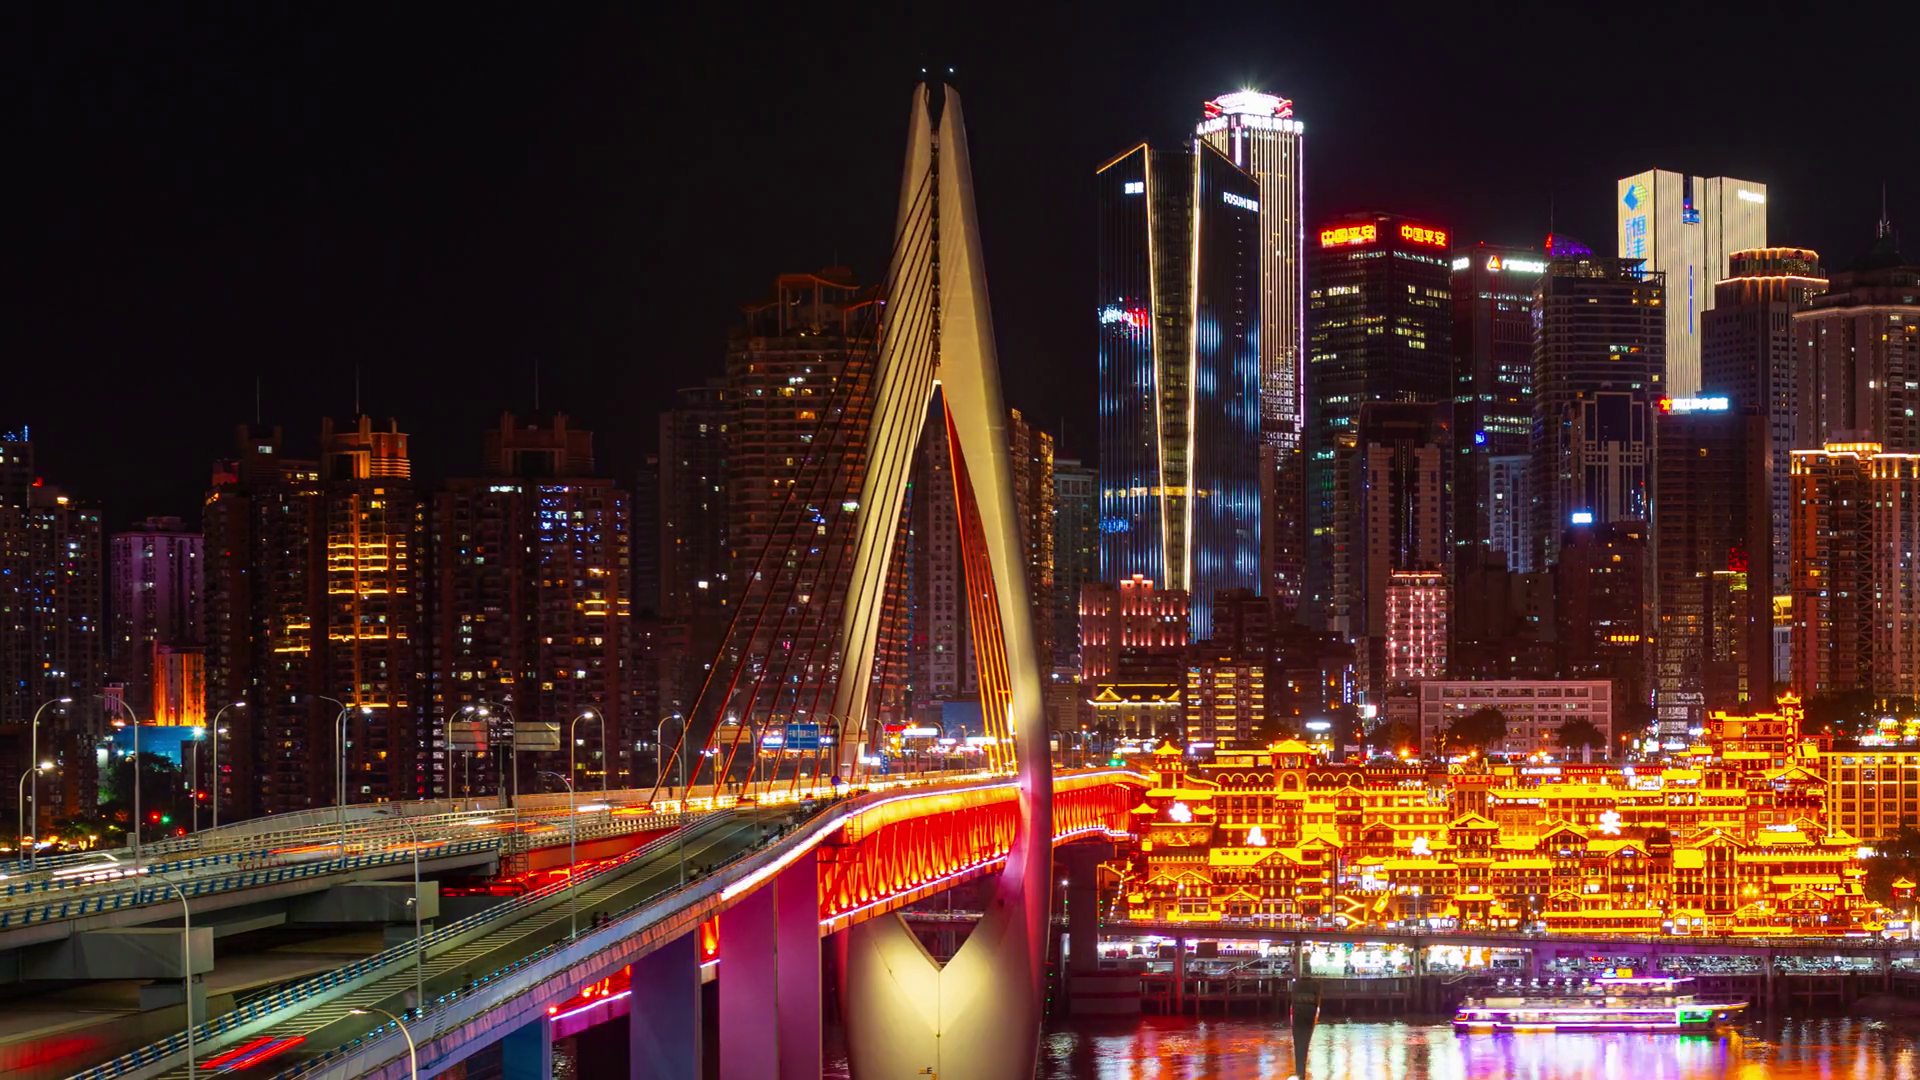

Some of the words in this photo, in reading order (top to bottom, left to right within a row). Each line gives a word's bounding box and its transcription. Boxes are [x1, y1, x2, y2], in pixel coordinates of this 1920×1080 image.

[1223, 191, 1247, 209] FOSUN
[1321, 225, 1375, 245] 中国平安
[1401, 225, 1446, 247] 中国平安
[1748, 723, 1783, 736] 洪崖洞
